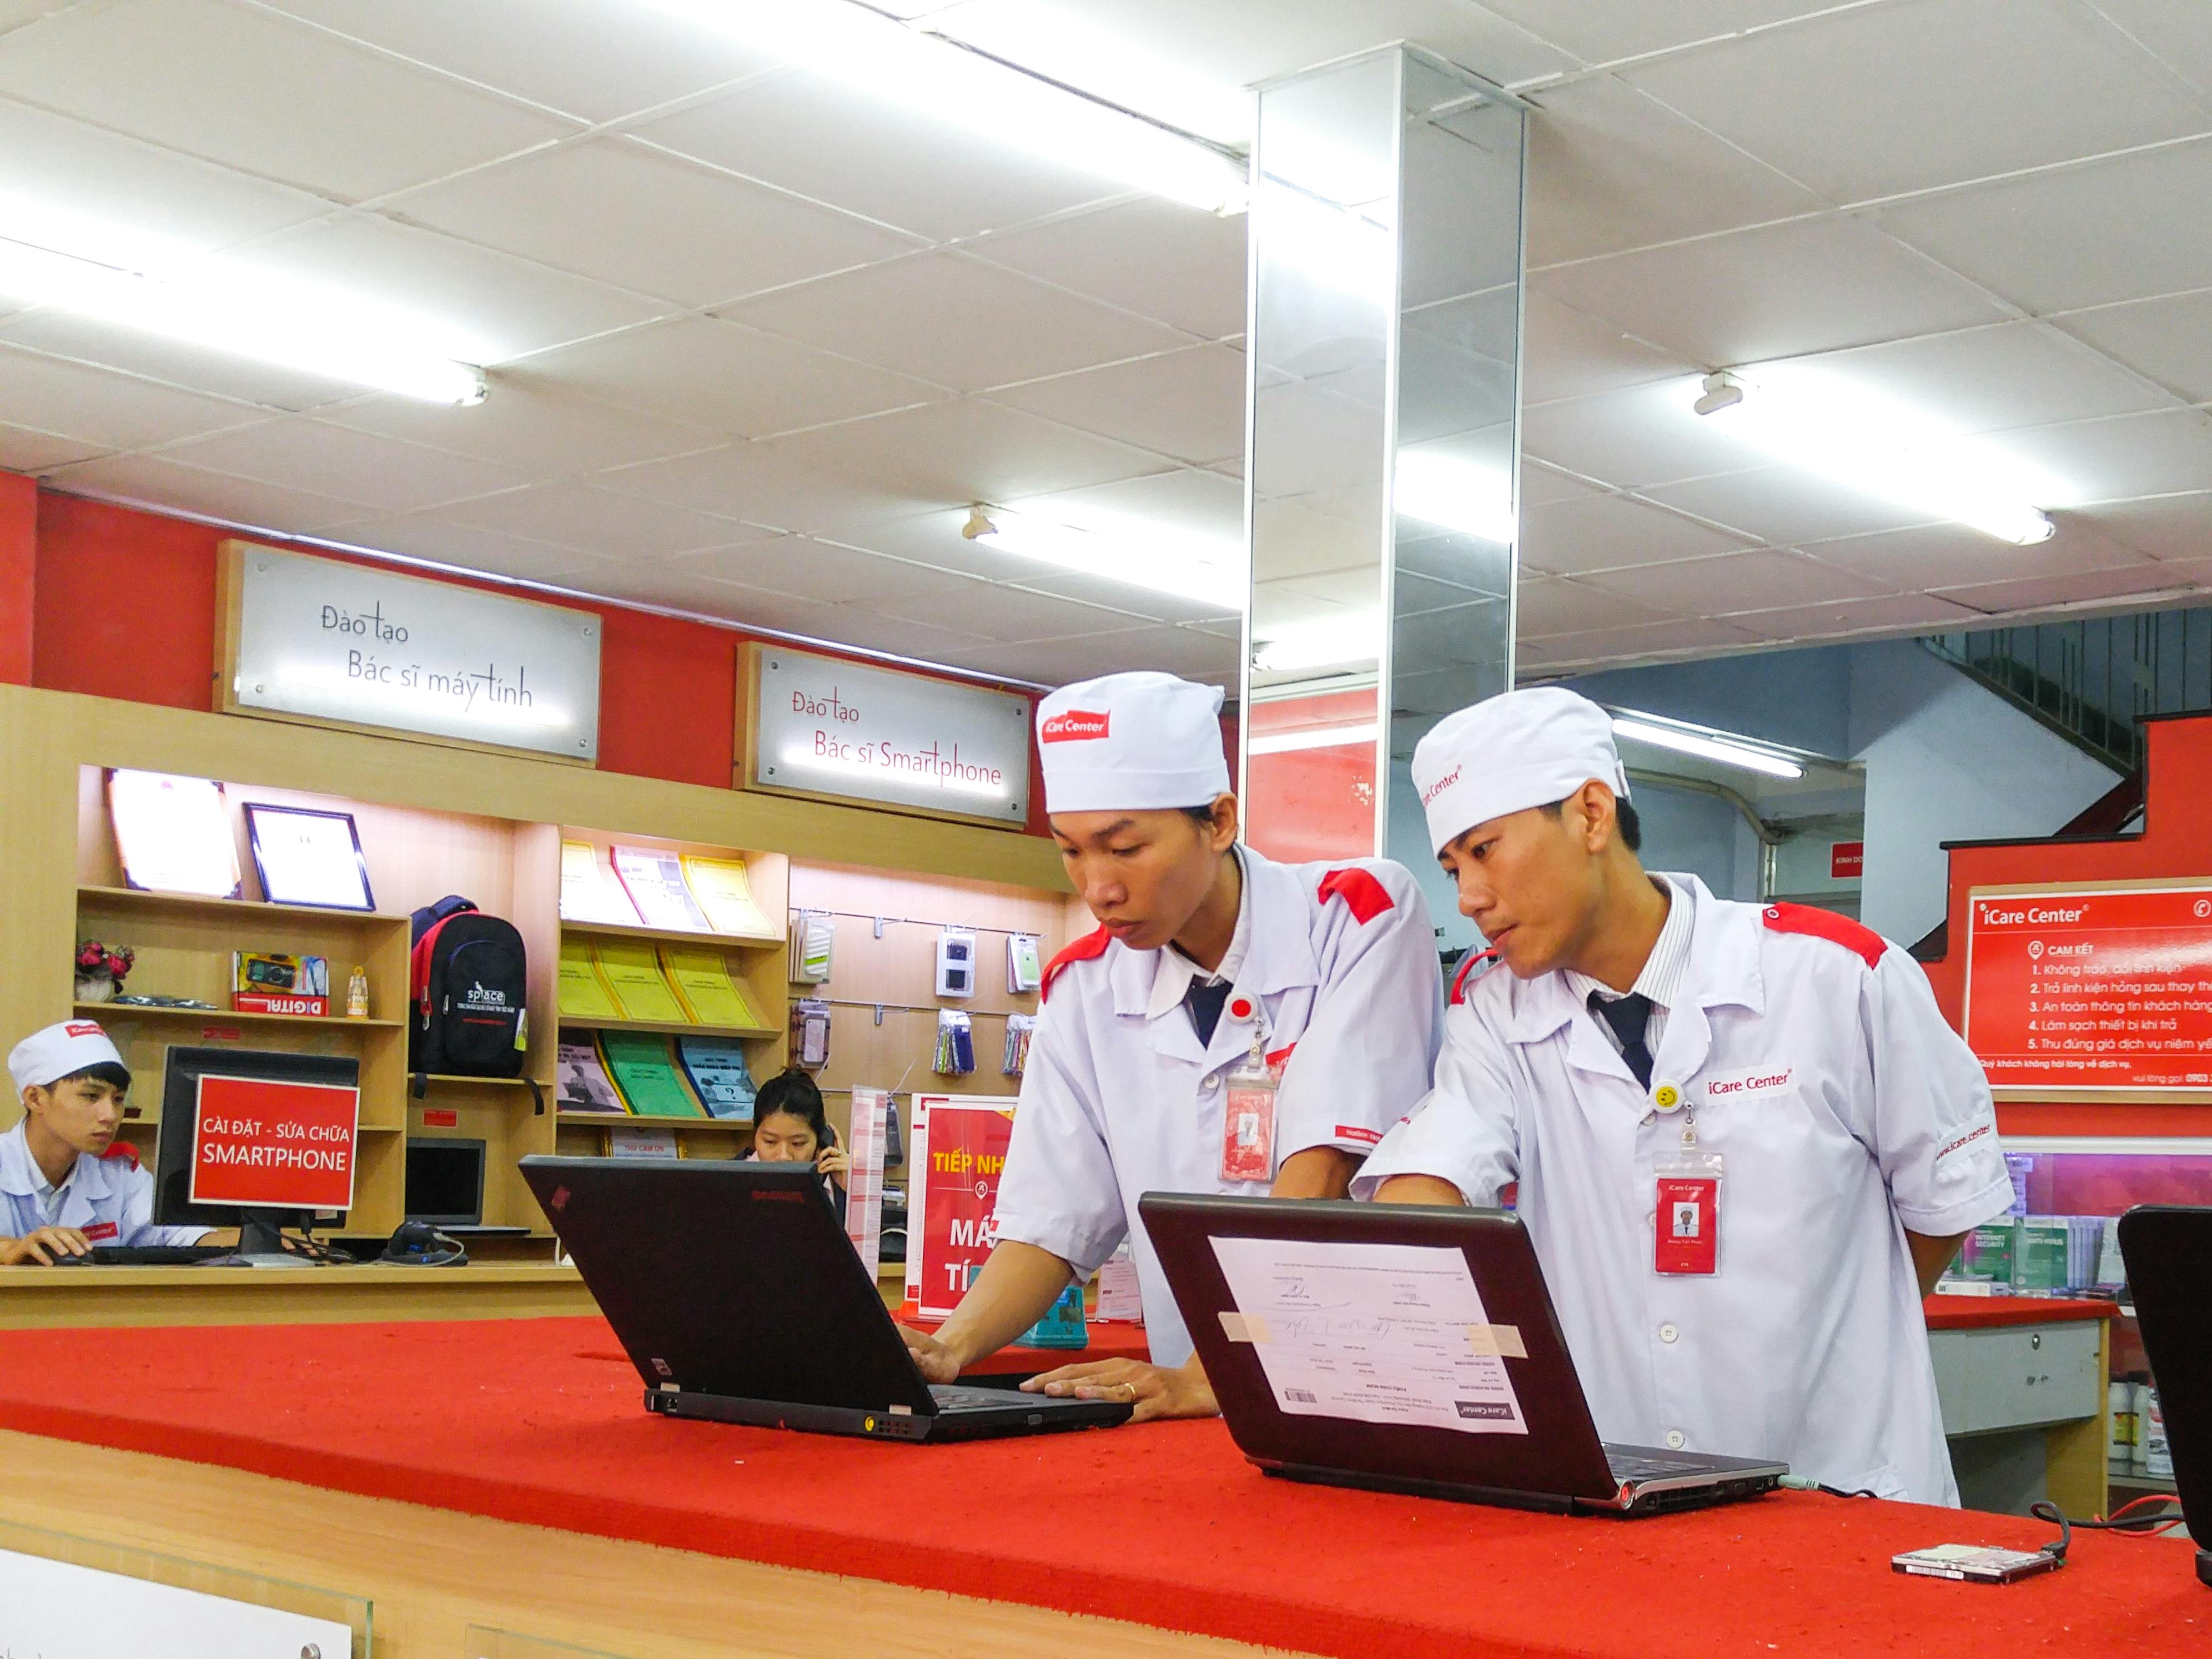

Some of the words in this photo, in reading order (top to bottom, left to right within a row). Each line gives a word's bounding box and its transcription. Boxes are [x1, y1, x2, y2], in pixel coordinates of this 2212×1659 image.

[322, 605, 366, 636] Đào
[361, 600, 409, 644] tạo
[348, 649, 391, 683] Bác
[400, 664, 420, 689] sĩ
[428, 671, 479, 712] máy
[471, 663, 532, 708] tính
[792, 691, 827, 717] Đào
[822, 686, 859, 723] tạo
[1065, 718, 1105, 732] Center
[815, 730, 851, 761] Bác
[858, 742, 876, 764] sĩ
[881, 740, 1002, 787] Smartphone
[1984, 909, 2025, 925] iCare
[2028, 907, 2082, 923] Center
[2047, 945, 2073, 956] CAM
[2043, 964, 2080, 977] Không
[2030, 983, 2041, 994] 2.
[2144, 984, 2165, 993] sau
[2167, 982, 2196, 993] thay
[239, 998, 321, 1015] DIGITAL
[2029, 1001, 2040, 1012] 3.
[2042, 1002, 2058, 1012] An
[2060, 1001, 2088, 1012] toàn
[2090, 1001, 2124, 1013] thông
[2126, 1001, 2141, 1011] tin
[2144, 1000, 2181, 1012] khách
[2028, 1019, 2039, 1031] 4.
[2041, 1020, 2066, 1031] Làm
[2141, 1020, 2158, 1030] khi
[2028, 1038, 2038, 1049] 5.
[2040, 1038, 2061, 1049] Thu
[2063, 1038, 2094, 1051] đúng
[1708, 1081, 1743, 1095] iCare
[1746, 1073, 1789, 1089] Center
[203, 1116, 228, 1134] CÀI
[232, 1118, 263, 1138] ĐẶT
[276, 1120, 305, 1139] SỬA
[309, 1125, 350, 1143] CHỮA
[203, 1143, 347, 1171] SMARTPHONE
[933, 1147, 973, 1173] TIẾP
[977, 1155, 1005, 1174] NH
[950, 1214, 993, 1249] MÁ
[944, 1259, 971, 1293] TÍ
